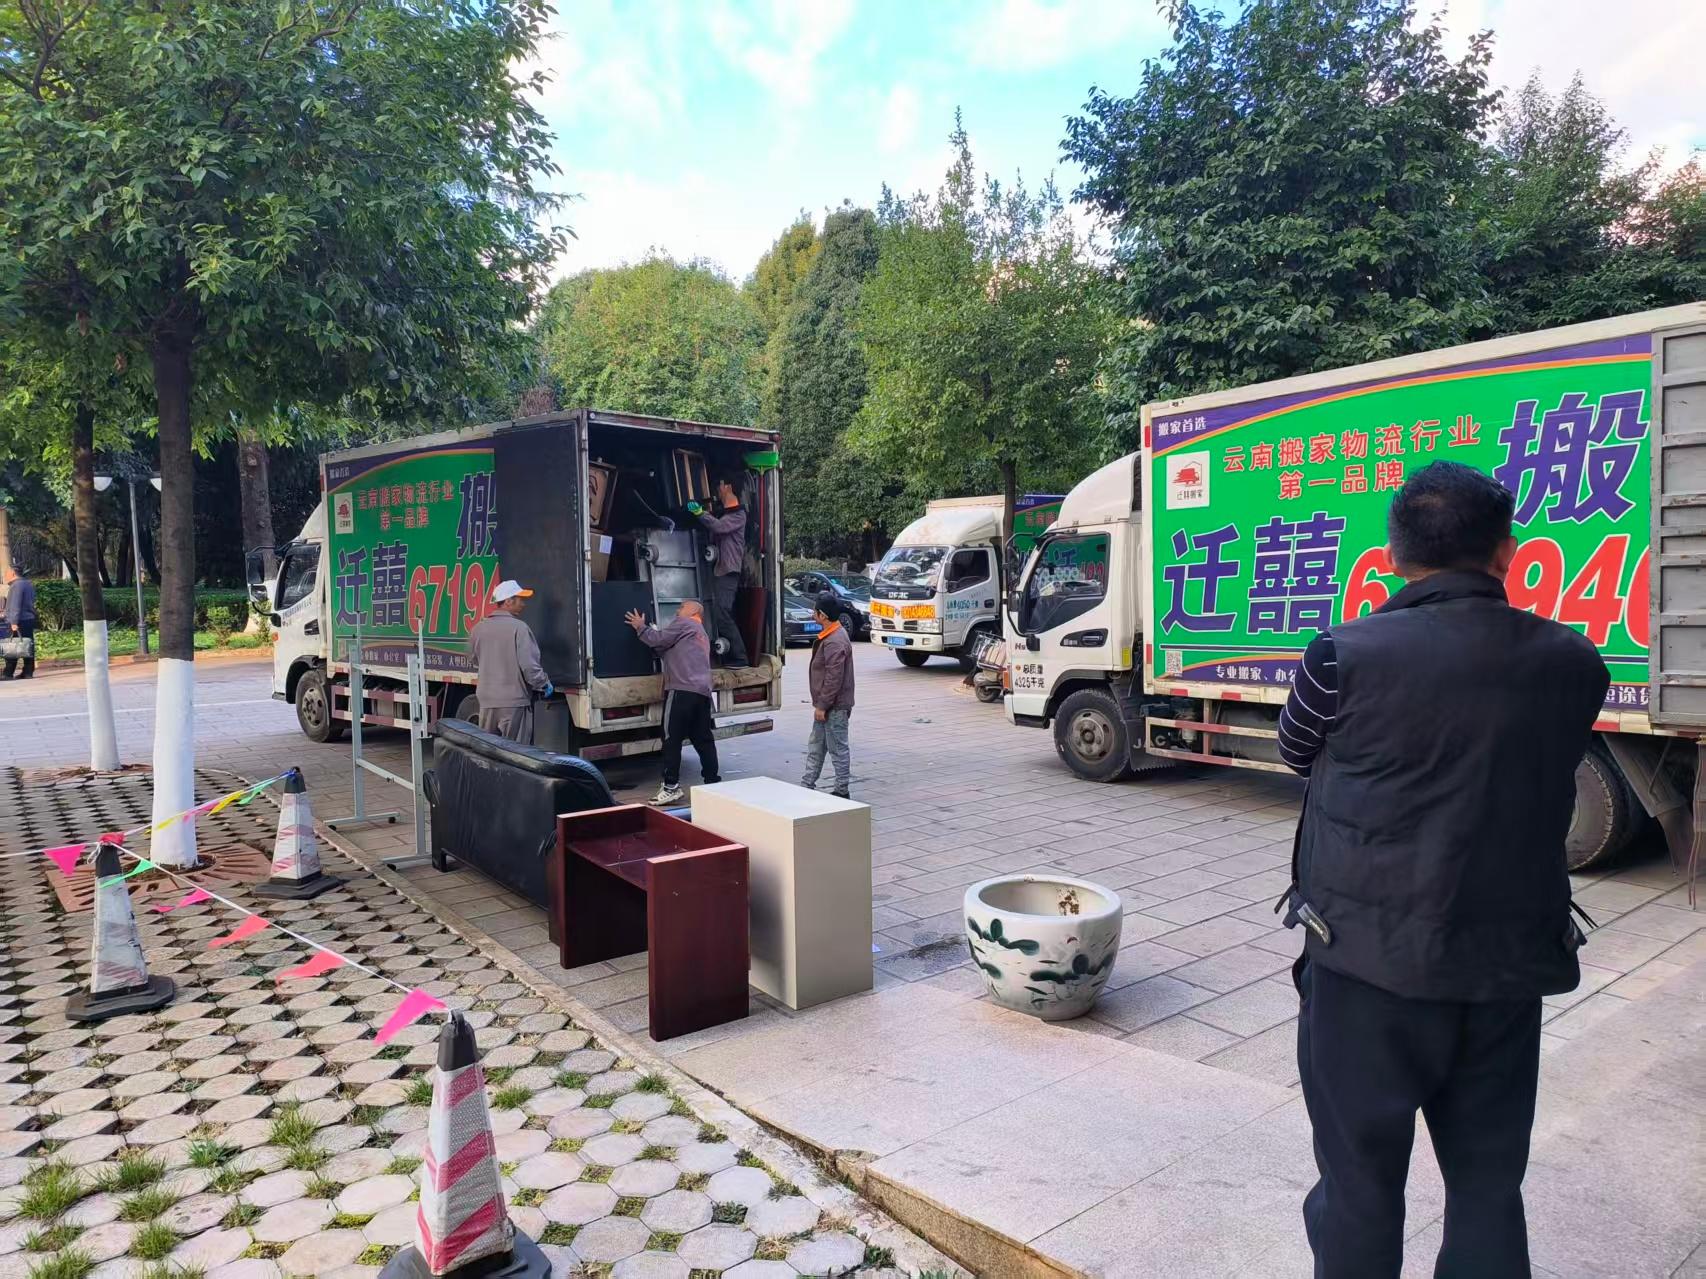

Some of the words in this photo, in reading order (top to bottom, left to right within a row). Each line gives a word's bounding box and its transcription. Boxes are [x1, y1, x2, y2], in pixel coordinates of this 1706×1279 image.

[1158, 416, 1207, 437] 搬家首选
[1222, 414, 1482, 473] 云南搬家物流行业
[1492, 388, 1650, 528] 搬
[1278, 459, 1406, 500] 第一品牌
[1015, 676, 1045, 689] 4325千克
[1023, 664, 1044, 675] 总质量
